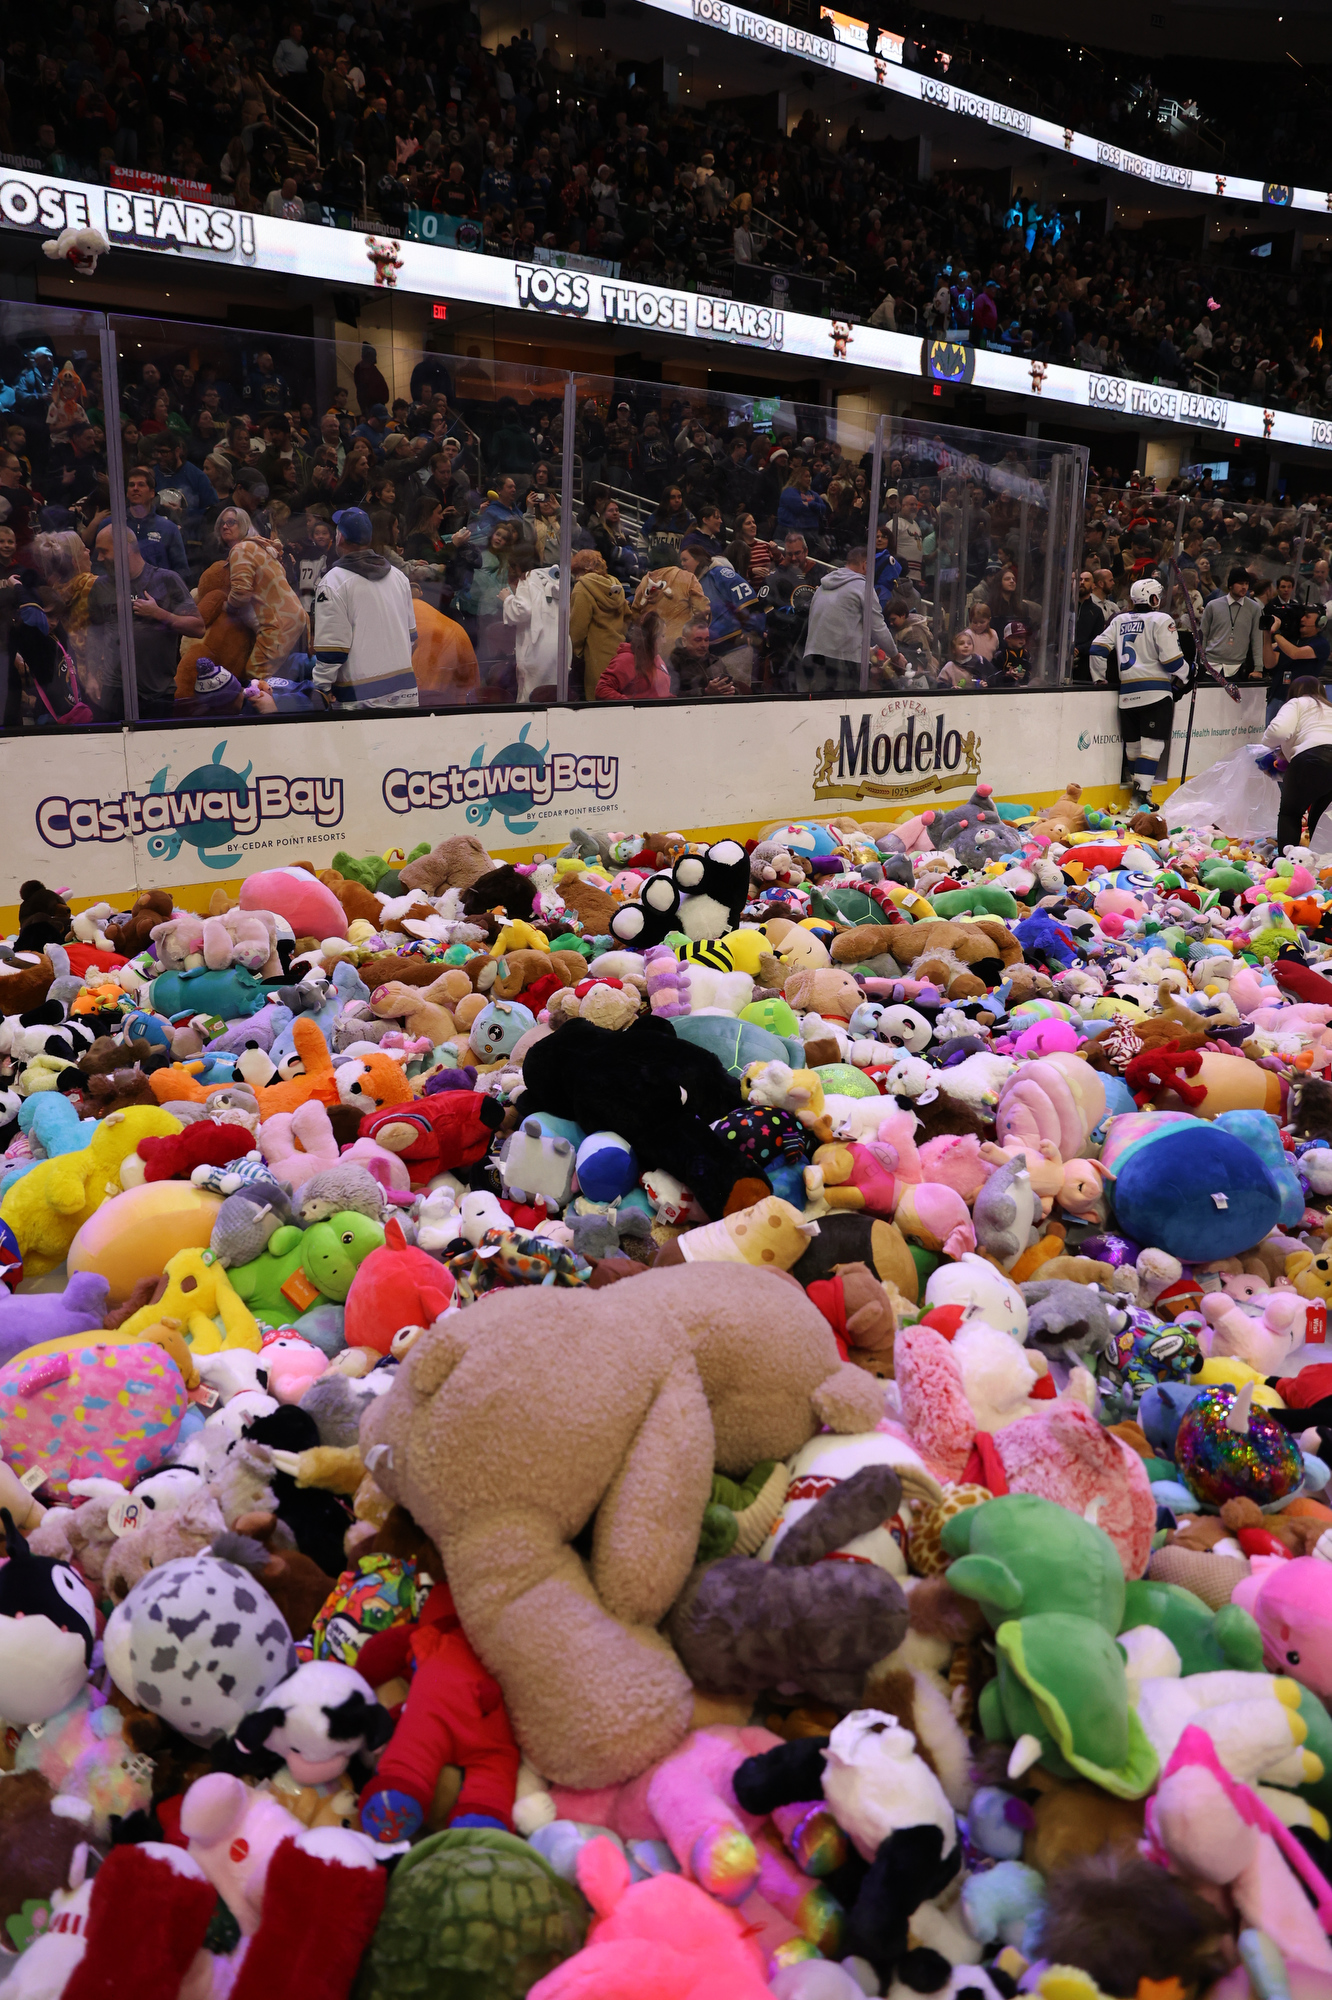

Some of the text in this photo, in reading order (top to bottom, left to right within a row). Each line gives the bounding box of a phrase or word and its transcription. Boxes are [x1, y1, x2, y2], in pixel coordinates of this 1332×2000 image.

[692, 0, 836, 65] TOSS THOSE BEARS!
[920, 77, 1032, 133] TOSS THOSE BEARS!
[1097, 142, 1193, 187] TOSS THOSE BEARS!
[0, 180, 256, 256] OSE BEARS!
[351, 216, 401, 236] Huntington
[697, 280, 733, 298] Huntington
[515, 264, 590, 314] TOSS
[601, 285, 687, 331] THOSE
[696, 297, 784, 344] BEARS!
[829, 307, 861, 322] Huntington
[1089, 375, 1127, 406] TOSS
[1132, 387, 1177, 419] THOSE
[1180, 393, 1229, 429] BEARS!
[1312, 420, 1332, 445] TOS
[731, 582, 753, 600] 73
[1120, 621, 1143, 635] SVOZIL
[1120, 633, 1138, 672] 5
[881, 700, 927, 717] CERVEZA
[1191, 728, 1210, 738] Health
[1211, 728, 1230, 737] Insurer
[1231, 726, 1237, 736] of
[1238, 726, 1247, 734] the
[837, 713, 961, 778] Modelo
[891, 787, 909, 797] 1925
[527, 804, 619, 820] BY CEDAR POINT RESORTS
[227, 832, 346, 852] BY CEDAR POINT RESORTS
